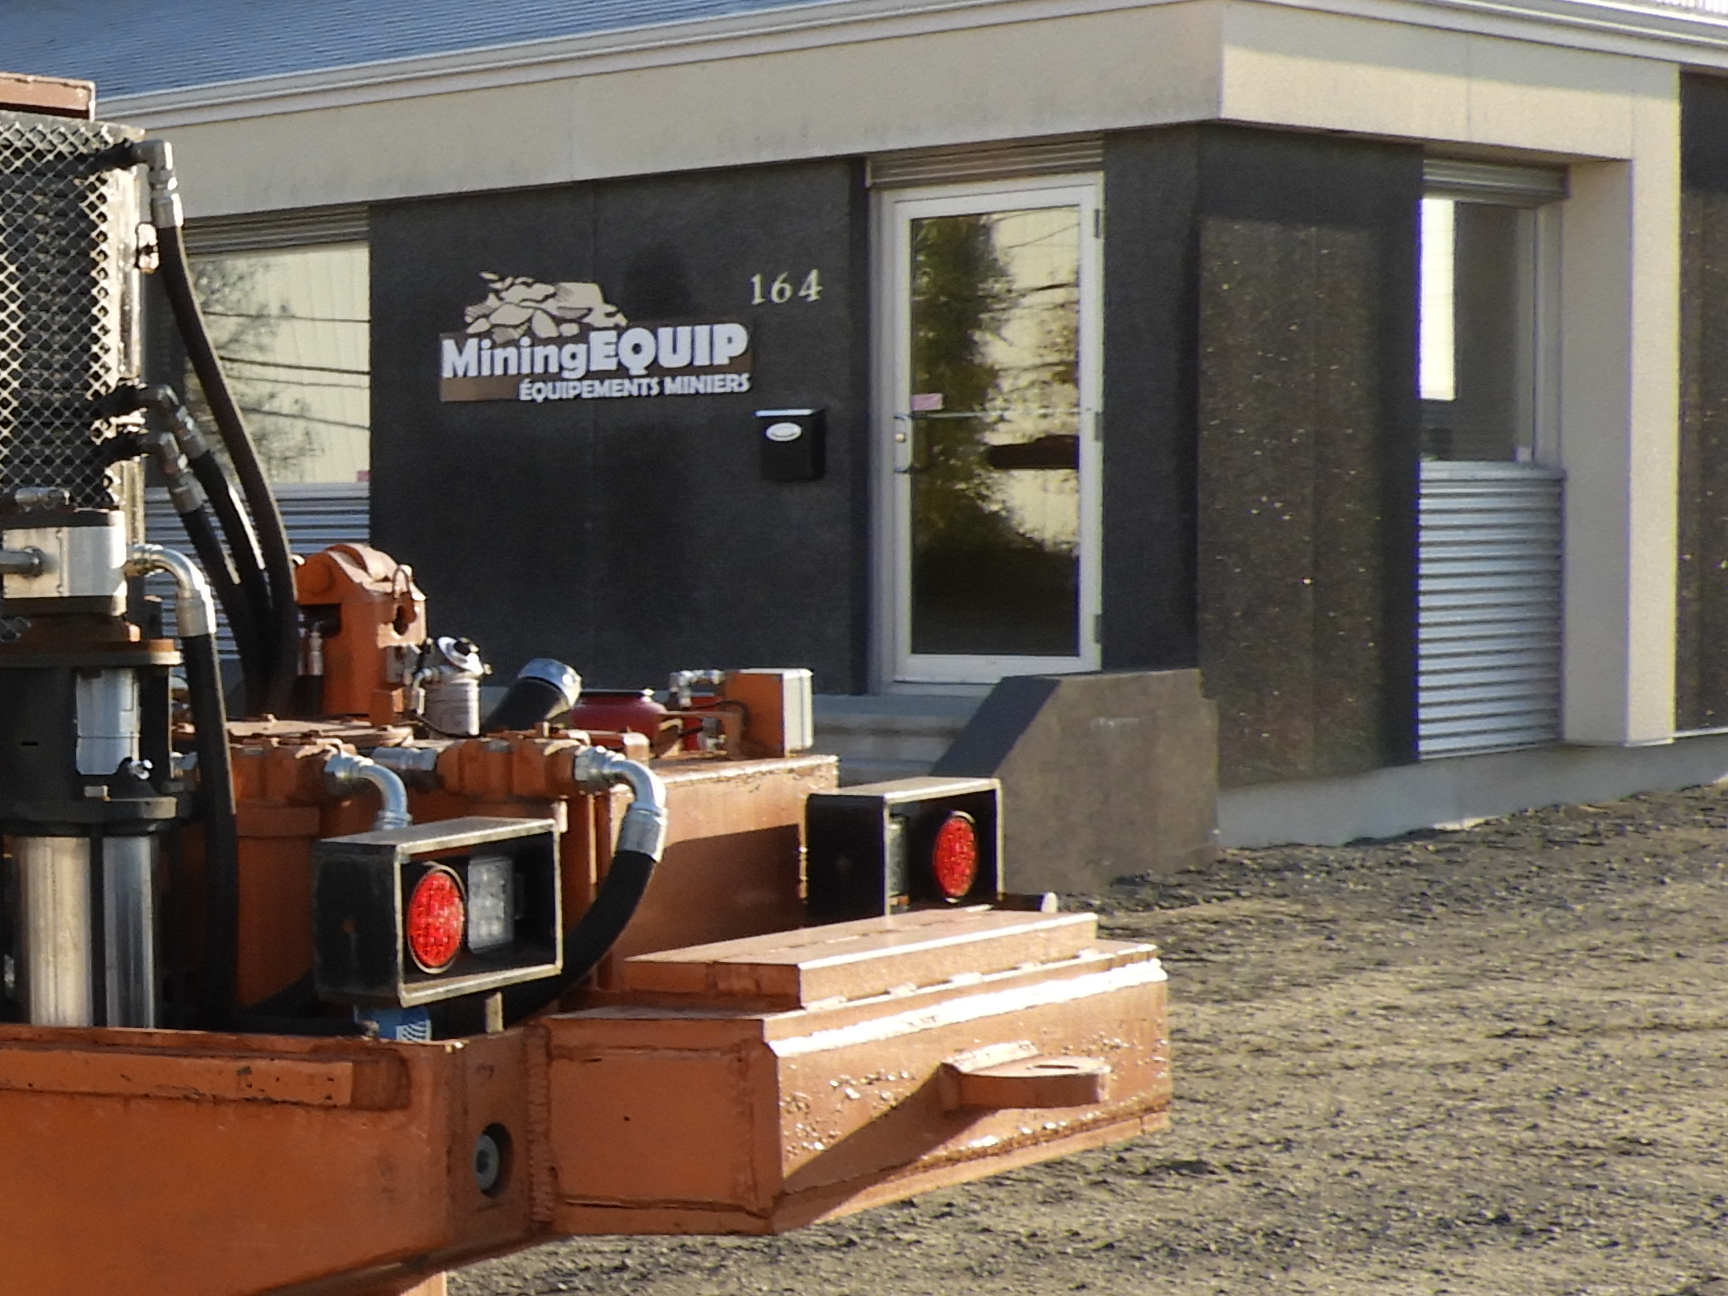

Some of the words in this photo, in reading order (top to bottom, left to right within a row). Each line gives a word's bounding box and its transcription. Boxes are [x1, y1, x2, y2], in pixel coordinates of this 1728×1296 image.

[750, 269, 823, 305] 164
[441, 323, 749, 379] MiningEQUIP
[519, 375, 660, 402] ÉQUIPEMENTS
[664, 373, 751, 395] MINIERS
